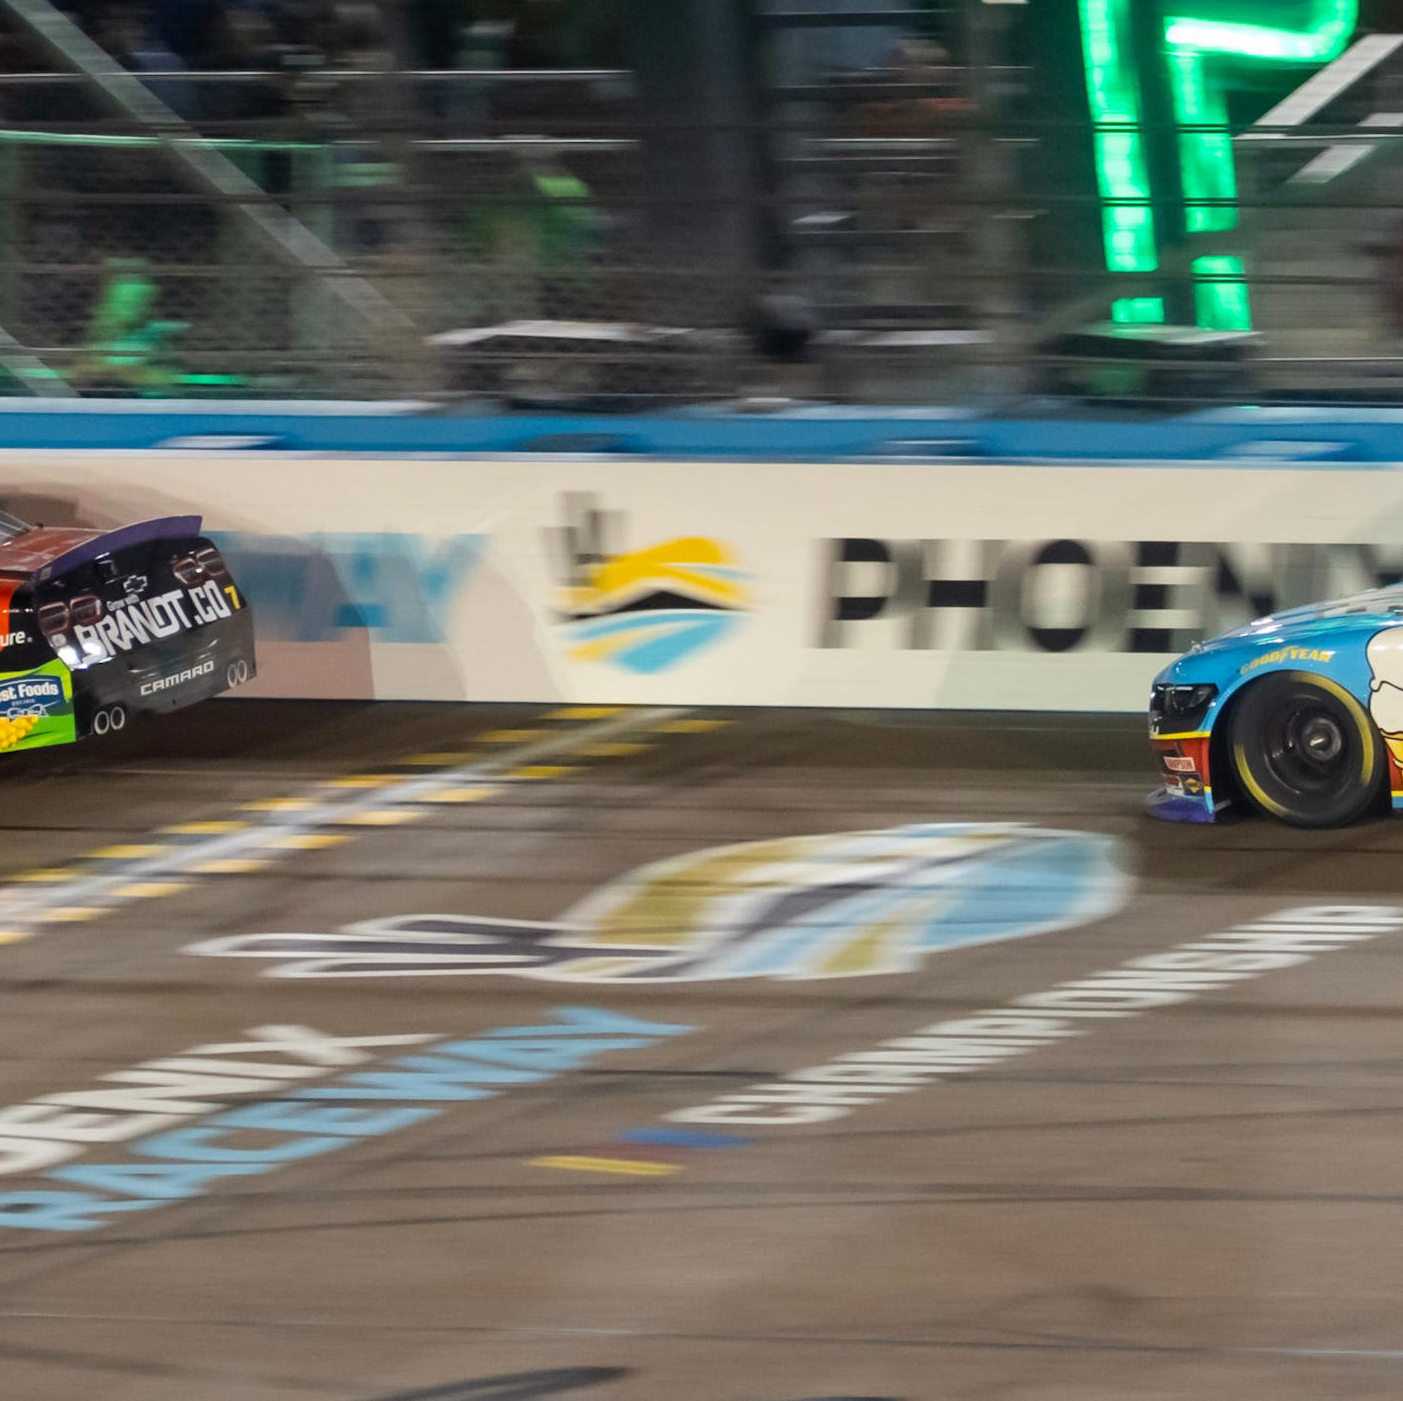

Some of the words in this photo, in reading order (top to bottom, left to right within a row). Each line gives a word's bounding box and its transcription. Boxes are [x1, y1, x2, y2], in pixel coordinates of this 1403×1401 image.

[224, 585, 241, 610] 7
[18, 681, 59, 700] Foods
[140, 660, 215, 696] CAMARO
